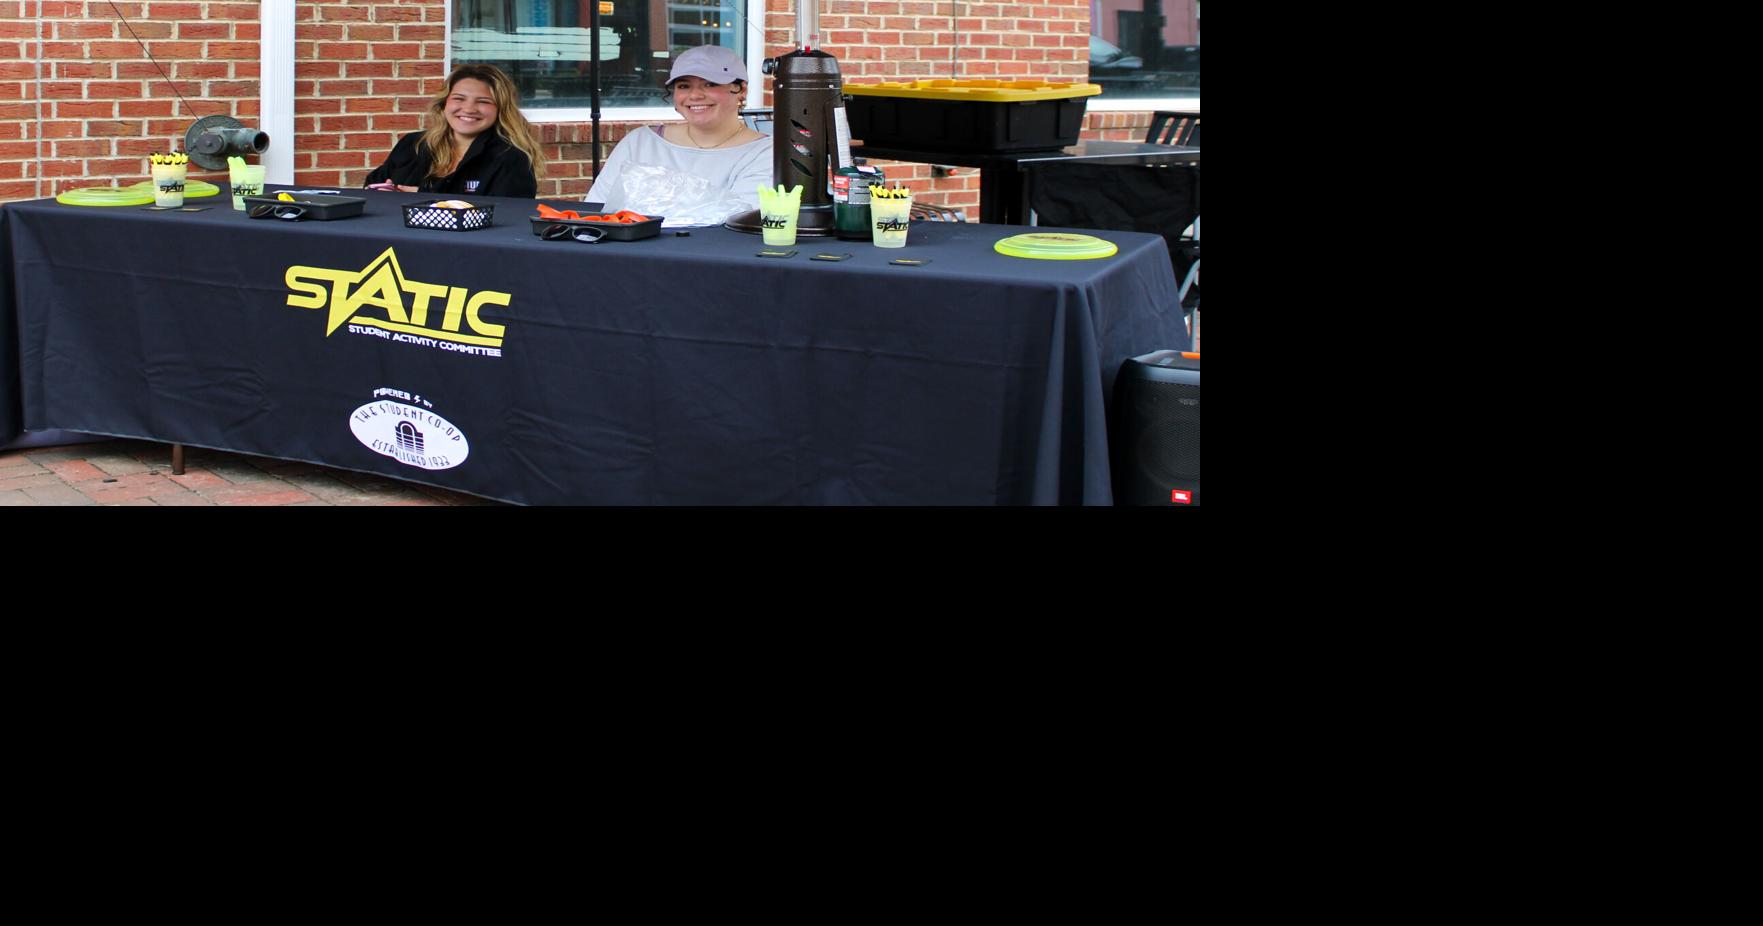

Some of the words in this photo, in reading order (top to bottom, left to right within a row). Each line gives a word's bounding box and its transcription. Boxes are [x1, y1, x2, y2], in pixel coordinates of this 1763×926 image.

[159, 181, 184, 193] STATI
[285, 246, 512, 337] STATIC
[348, 324, 391, 340] STUDENT
[392, 333, 438, 348] ACTIVITY
[438, 341, 502, 357] COMMITTEE
[373, 387, 411, 401] POWERED
[354, 405, 379, 424] THE
[379, 402, 424, 421] STUDENT
[427, 415, 462, 443] CO-OP
[371, 438, 427, 467] ESTABLISHED
[428, 455, 451, 467] 1933
